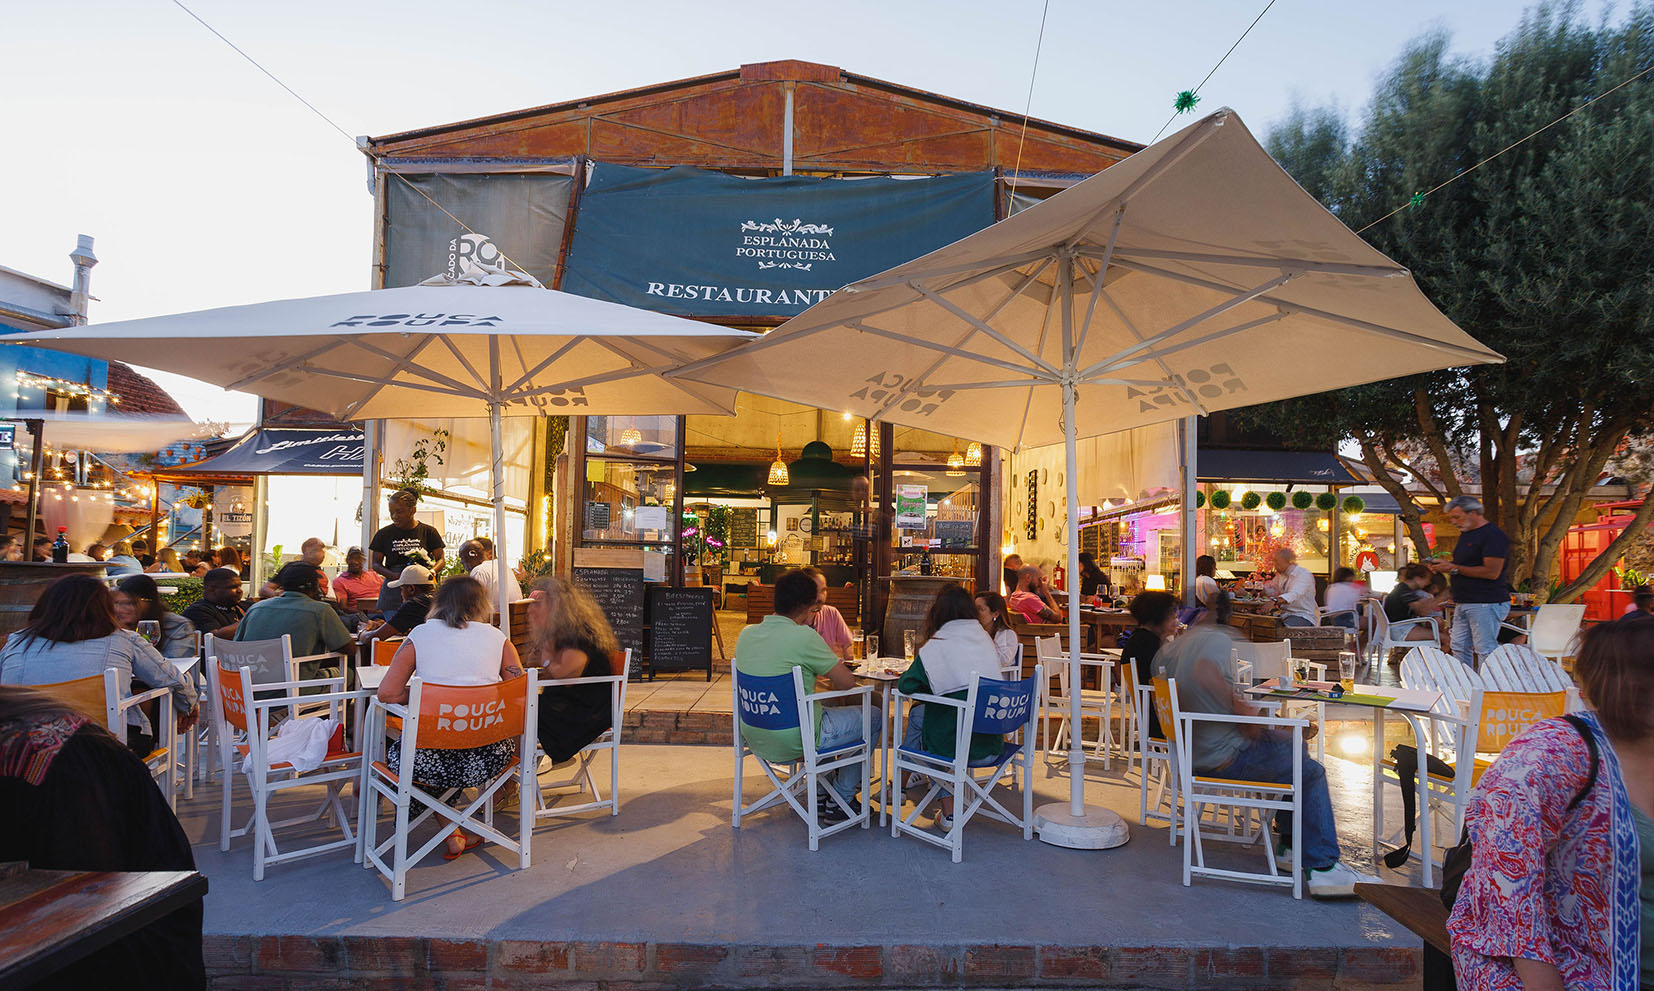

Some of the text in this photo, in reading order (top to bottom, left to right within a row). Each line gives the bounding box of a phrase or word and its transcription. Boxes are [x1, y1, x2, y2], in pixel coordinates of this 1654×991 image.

[743, 235, 830, 250] ESPLANADA
[447, 238, 458, 279] CADO DA
[735, 247, 837, 262] PORTUGUESA
[645, 281, 838, 305] RESTAURANT
[439, 698, 506, 716] POUCA
[1486, 708, 1544, 722] POUCA
[437, 712, 504, 732] ROUPA
[1486, 721, 1531, 737] ROUP
